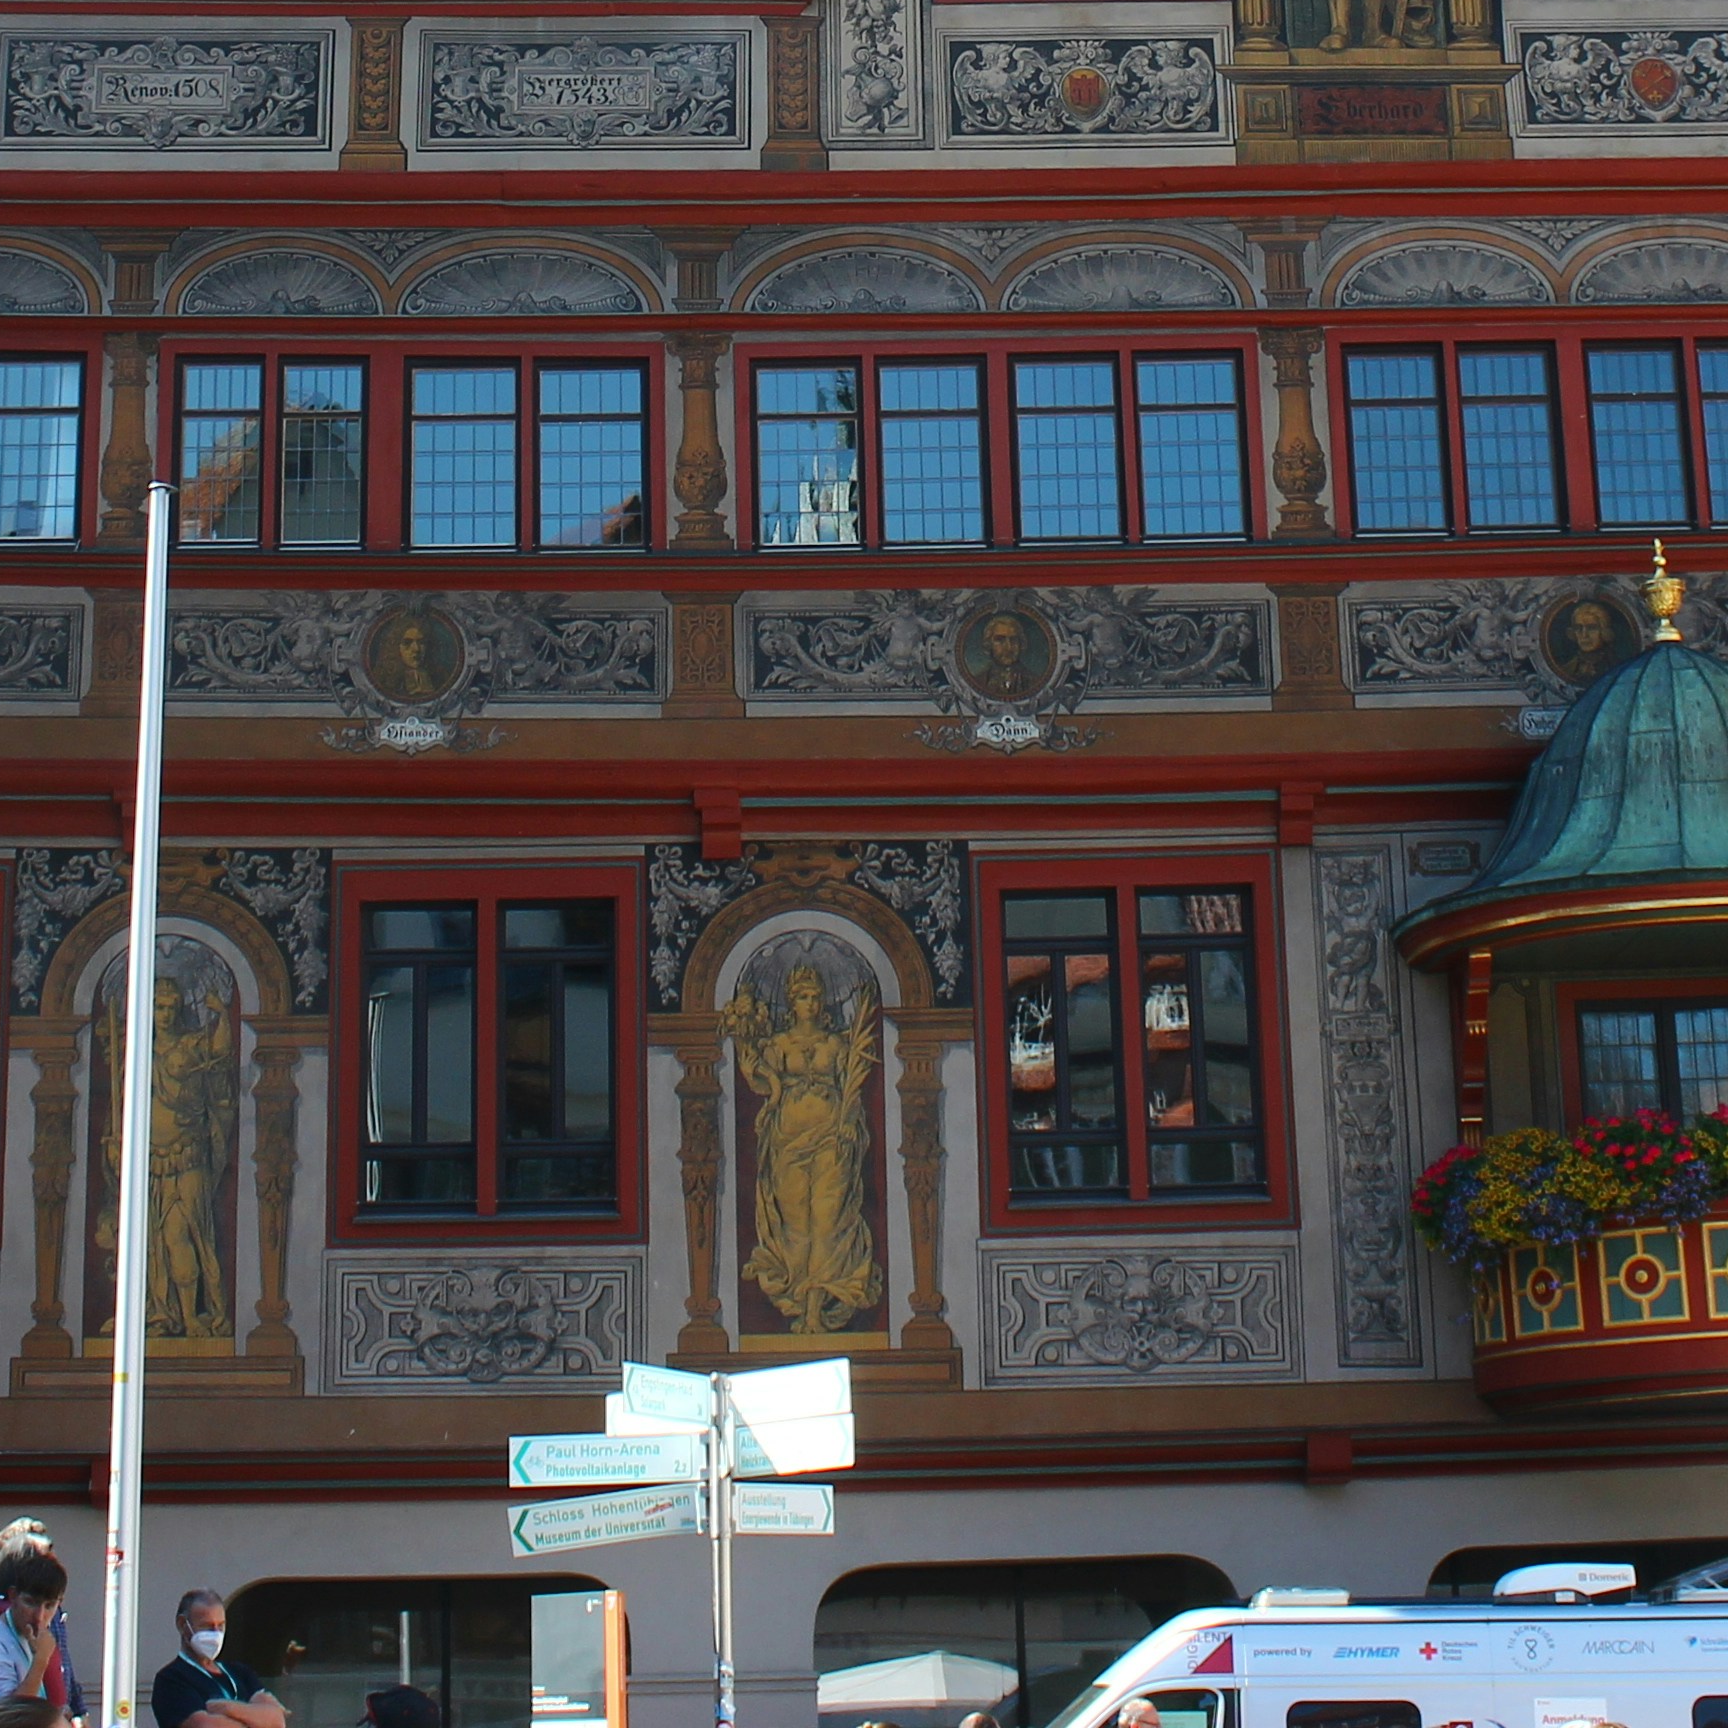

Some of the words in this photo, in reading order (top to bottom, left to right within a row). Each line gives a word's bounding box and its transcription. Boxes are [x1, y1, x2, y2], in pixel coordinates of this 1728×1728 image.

[1314, 94, 1426, 124] Eberhard
[546, 1445, 576, 1458] Paul
[580, 1444, 660, 1457] Horn-Arena
[546, 1462, 646, 1479] Photovoltaikanlage
[533, 1508, 584, 1526] Schloss
[535, 1529, 582, 1546] Museum
[584, 1525, 602, 1539] der
[605, 1516, 666, 1536] Universität
[1589, 1572, 1630, 1582] Dometic
[1253, 1647, 1297, 1658] powered
[1300, 1646, 1312, 1658] by
[1342, 1646, 1400, 1659] HYMER
